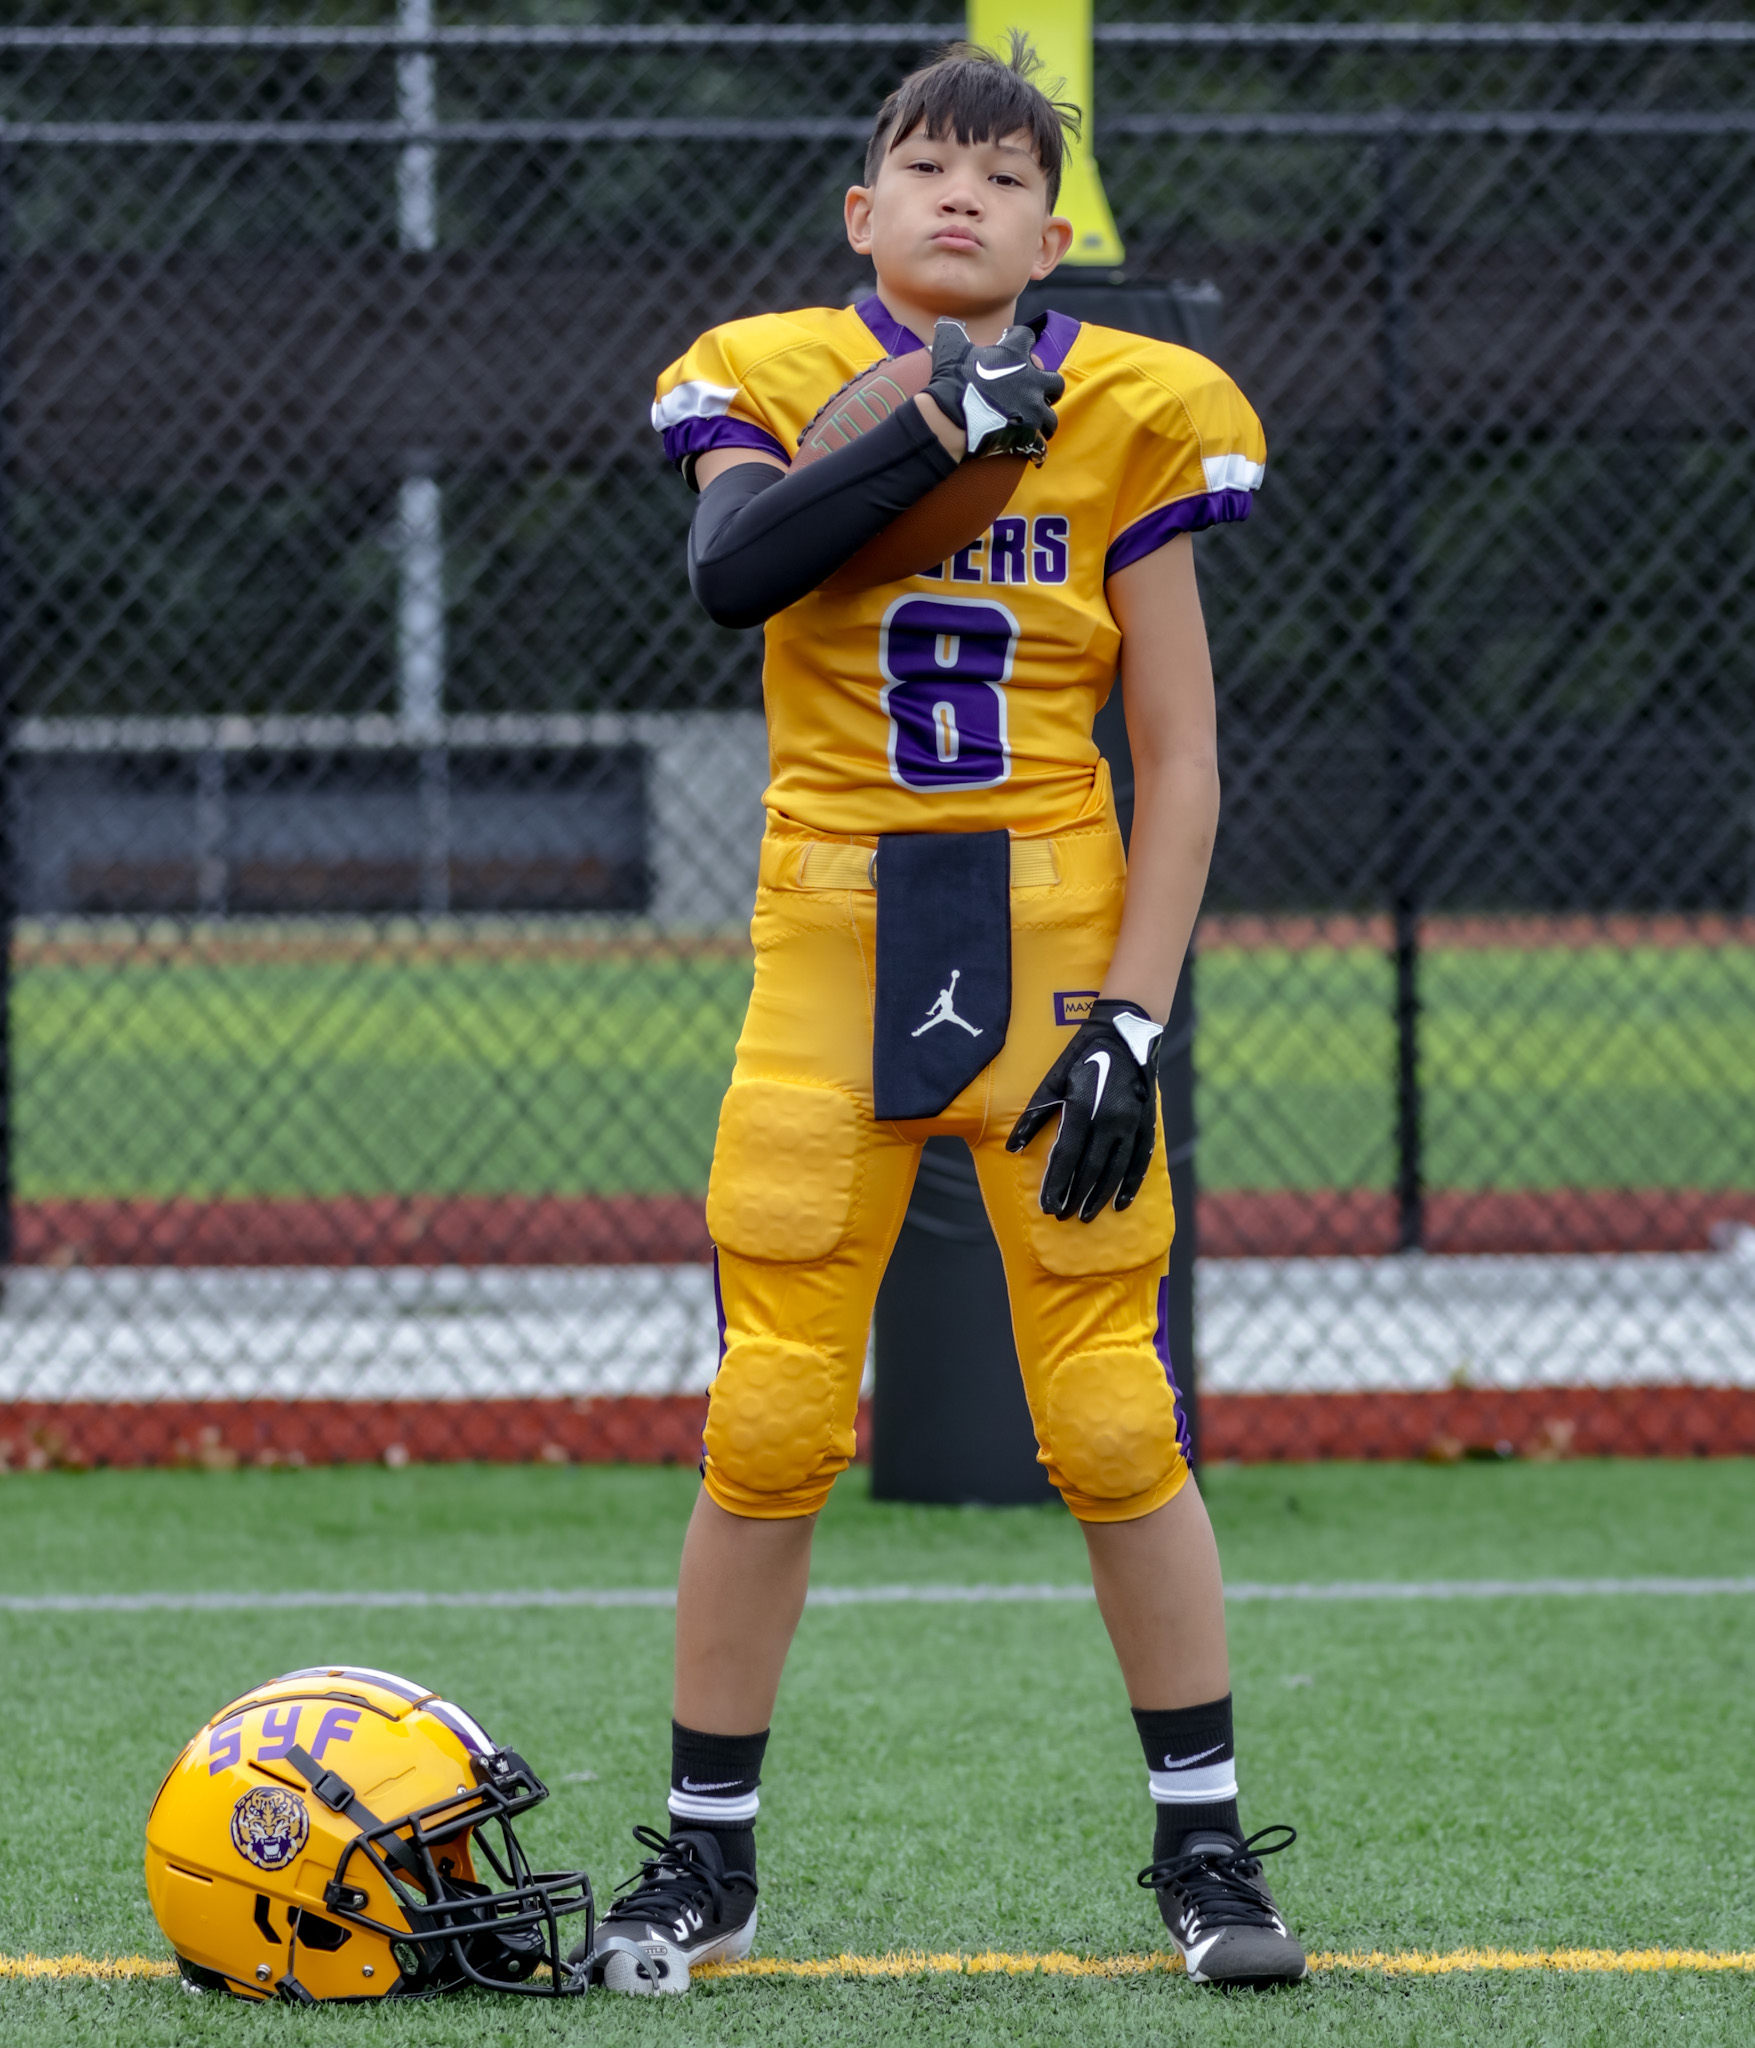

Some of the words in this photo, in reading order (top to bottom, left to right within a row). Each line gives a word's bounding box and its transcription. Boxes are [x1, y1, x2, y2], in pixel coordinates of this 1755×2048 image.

[914, 514, 1070, 586] ERS
[879, 592, 1021, 794] 8
[1065, 1002, 1094, 1013] MAX
[209, 1706, 362, 1777] SYF
